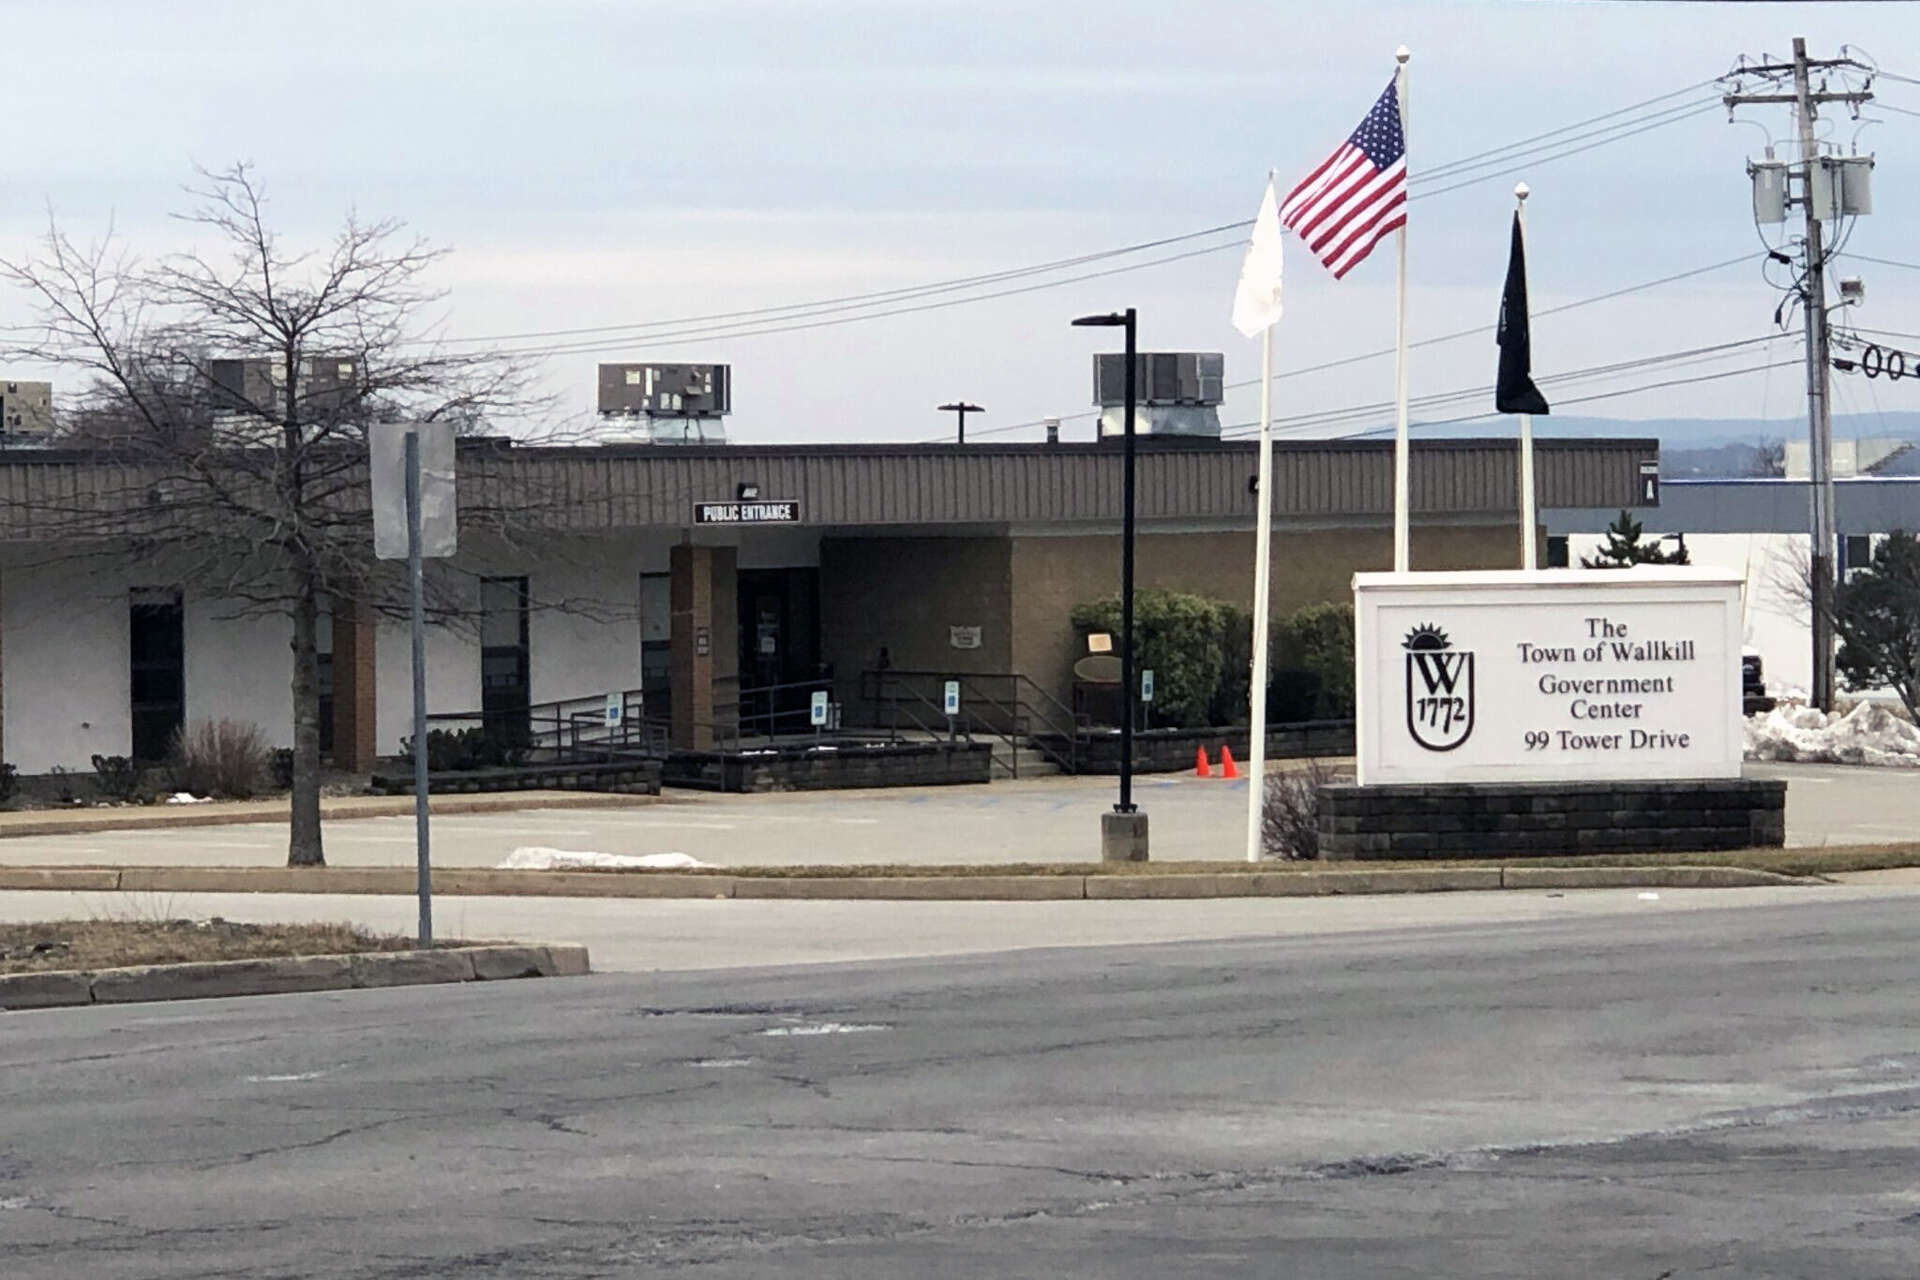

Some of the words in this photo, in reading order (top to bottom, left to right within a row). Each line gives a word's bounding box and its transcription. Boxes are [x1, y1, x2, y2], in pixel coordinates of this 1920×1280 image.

[703, 504, 740, 521] PUBLIC
[741, 503, 792, 520] ENTRANCE
[1585, 618, 1628, 638] The
[1517, 643, 1576, 663] Town
[1583, 641, 1604, 662] of
[1609, 640, 1695, 661] Wallkill
[1412, 652, 1470, 695] W
[1538, 674, 1674, 695] Government
[1417, 697, 1466, 734] 1772
[1570, 699, 1643, 719] Center
[1524, 731, 1549, 751] 99
[1556, 730, 1623, 750] Tower
[1629, 729, 1691, 749] Drive
